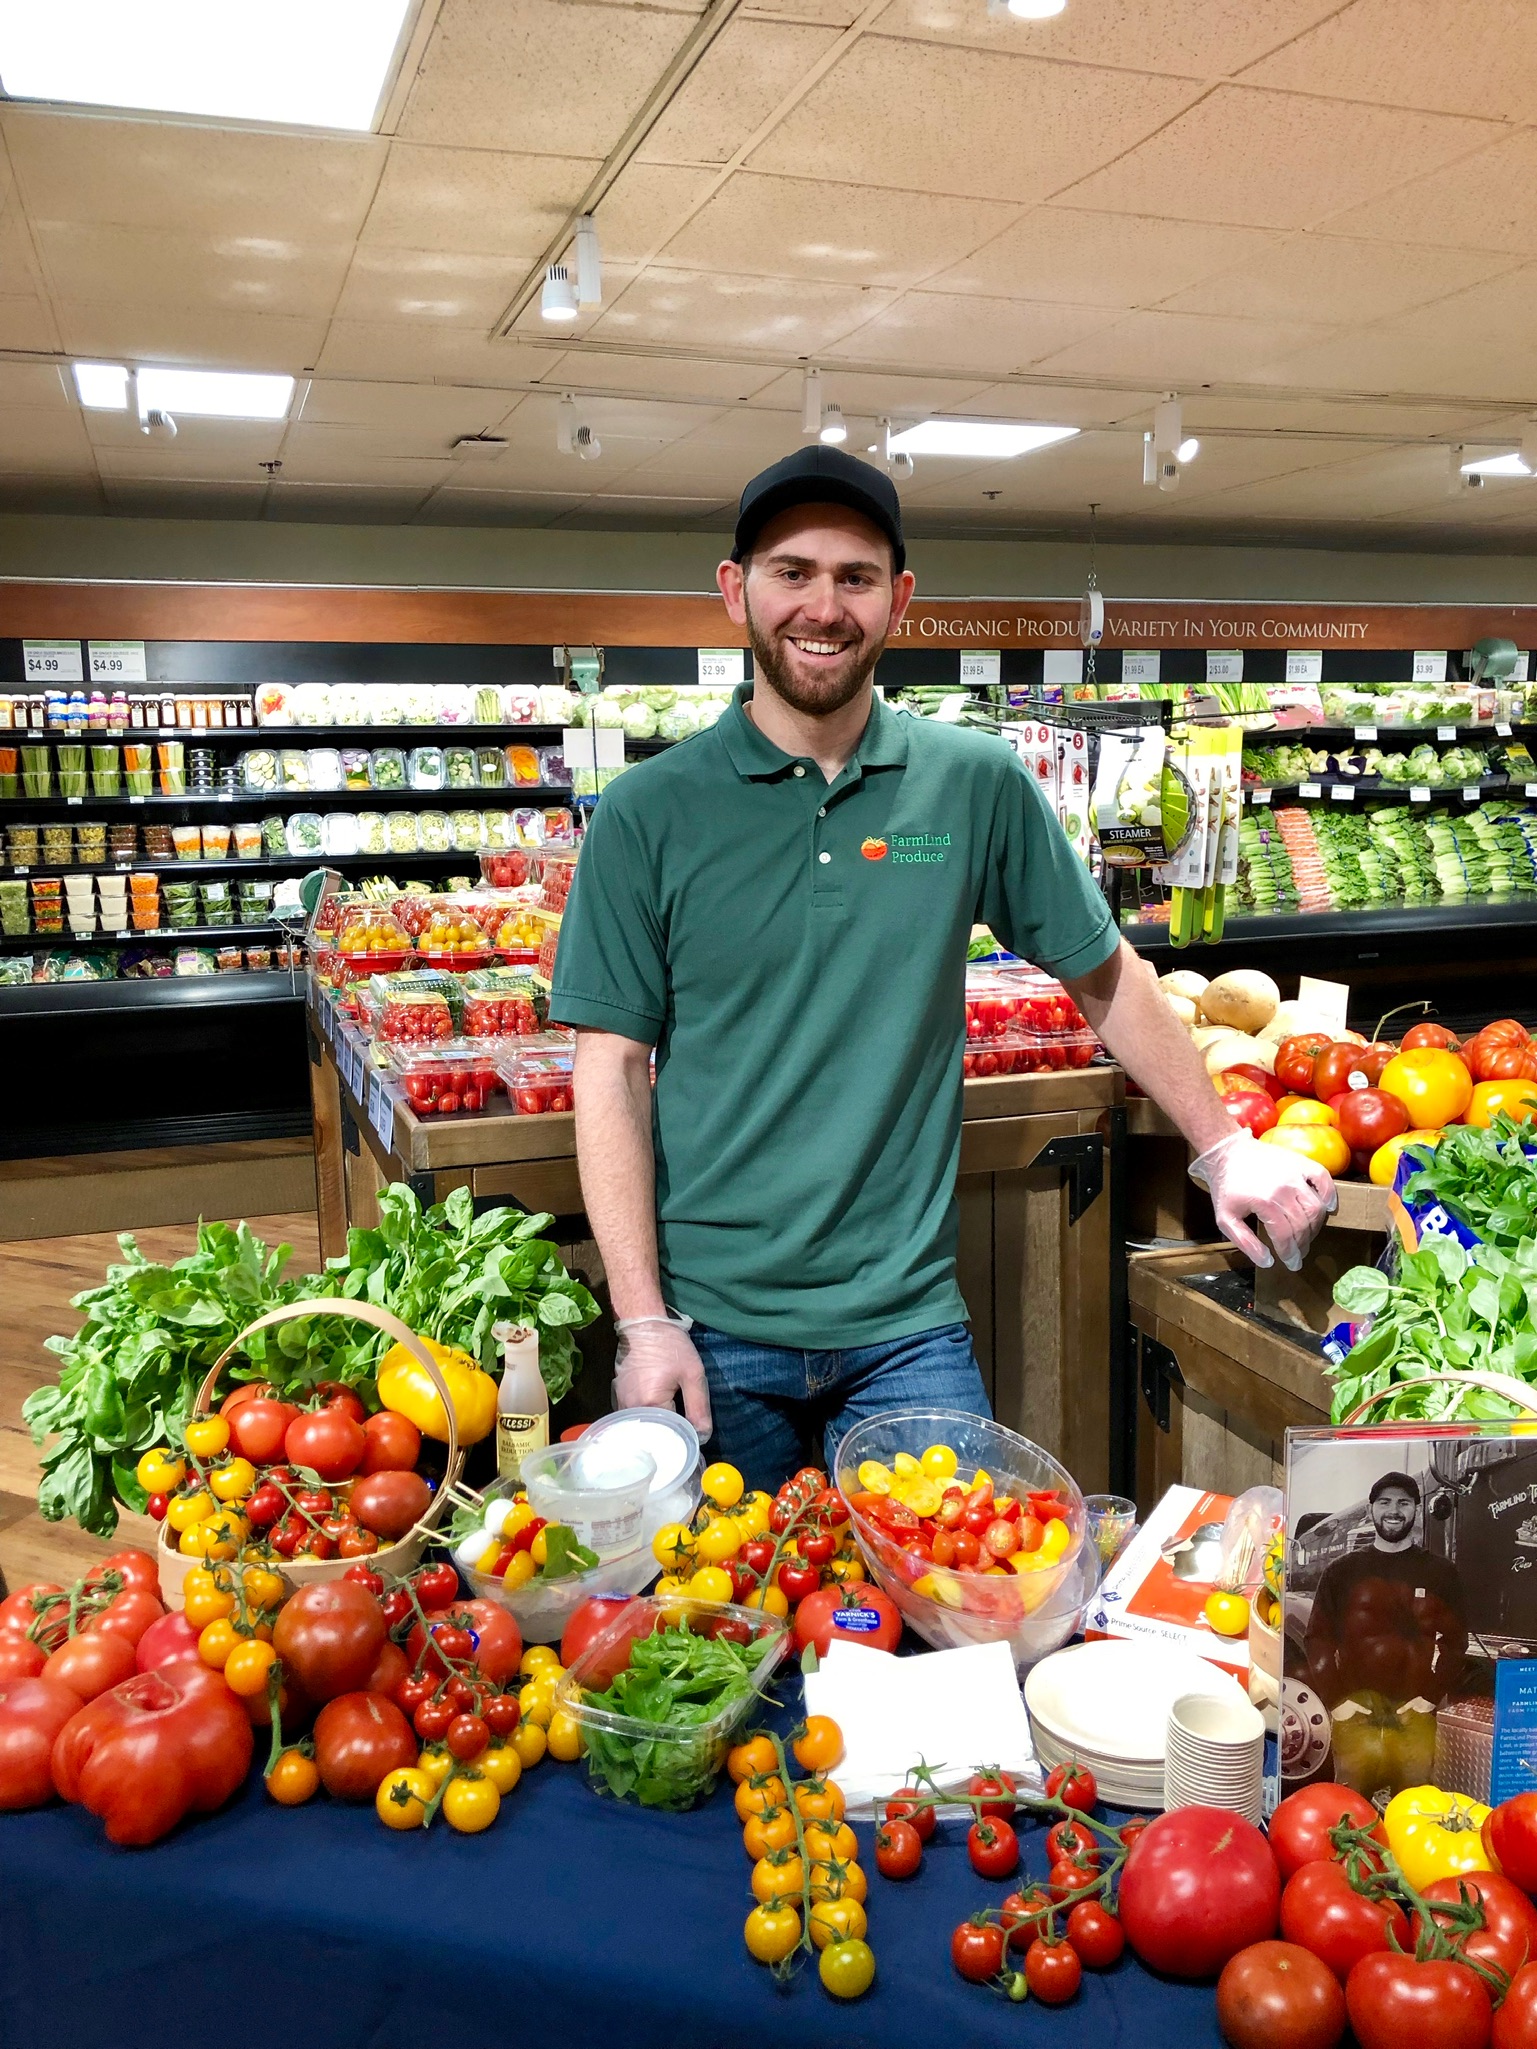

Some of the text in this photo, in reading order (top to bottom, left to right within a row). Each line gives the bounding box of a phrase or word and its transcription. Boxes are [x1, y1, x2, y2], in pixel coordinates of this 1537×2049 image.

[28, 659, 59, 671] $4.99
[93, 659, 123, 671] $4.99
[702, 665, 726, 675] $2.99
[976, 665, 985, 675] EA
[1137, 665, 1145, 675] EA
[1300, 664, 1308, 674] EA
[1416, 664, 1433, 674] $3.99
[1109, 828, 1152, 840] STEAMER
[891, 833, 951, 847] FarmLind
[892, 850, 944, 863] Produce
[501, 1418, 532, 1430] ALESSI
[835, 1611, 876, 1619] YARNICK'S
